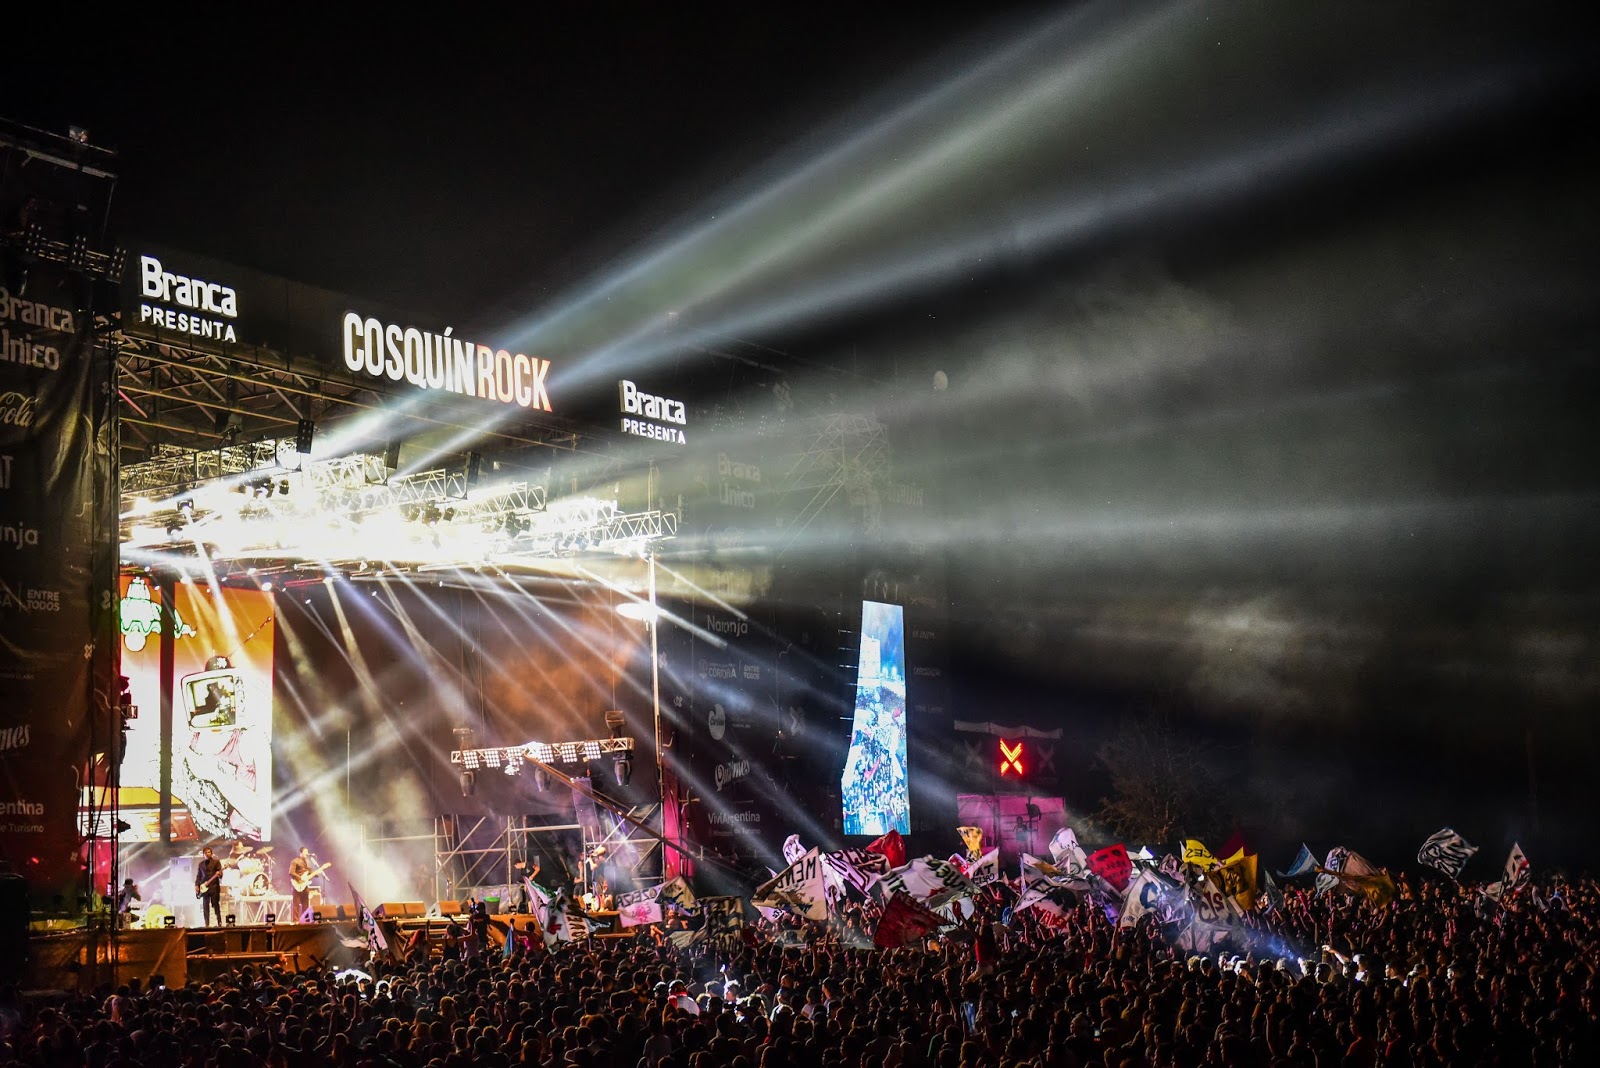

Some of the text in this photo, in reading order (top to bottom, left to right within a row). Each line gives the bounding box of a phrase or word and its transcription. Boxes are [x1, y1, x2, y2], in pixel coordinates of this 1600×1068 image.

[141, 255, 237, 317] Branca
[140, 304, 237, 343] PRESENTA
[620, 379, 687, 425] Branca
[621, 418, 687, 444] PRESENTA
[26, 599, 60, 611] TODOS
[27, 589, 60, 601] ENTRE
[707, 614, 748, 637] Naranja
